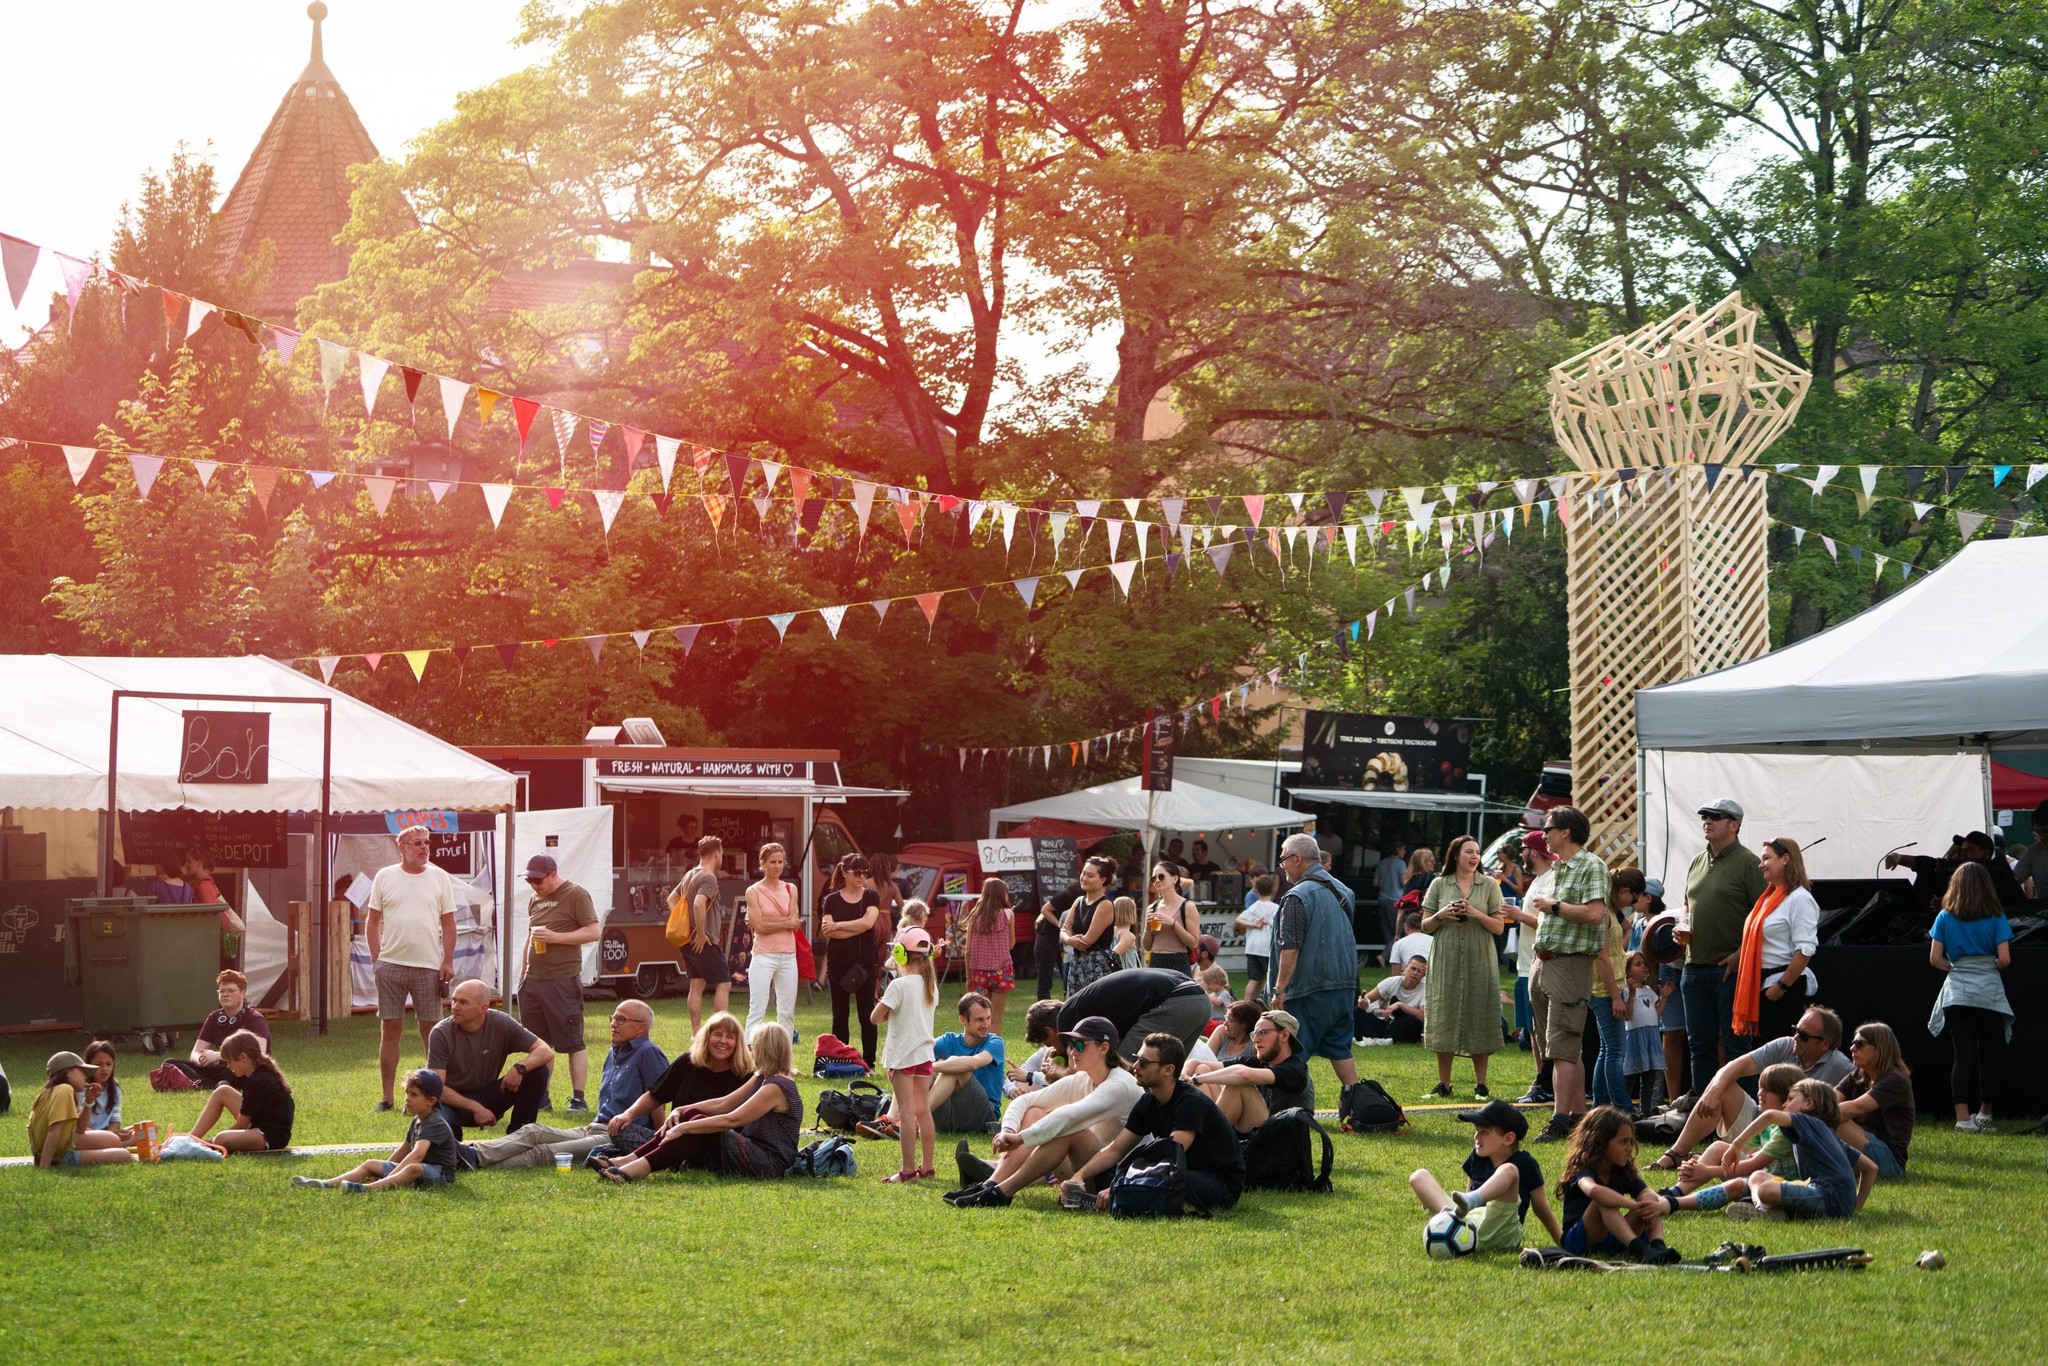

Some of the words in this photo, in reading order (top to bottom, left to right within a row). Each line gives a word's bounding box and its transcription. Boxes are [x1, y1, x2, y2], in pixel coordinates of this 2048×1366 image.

[1354, 736, 1372, 744] MOMO
[181, 716, 269, 782] Bar
[612, 761, 642, 773] FRESH
[652, 762, 694, 774] NATURAL
[703, 763, 753, 775] HANDMADE
[225, 843, 273, 863] DEPOT
